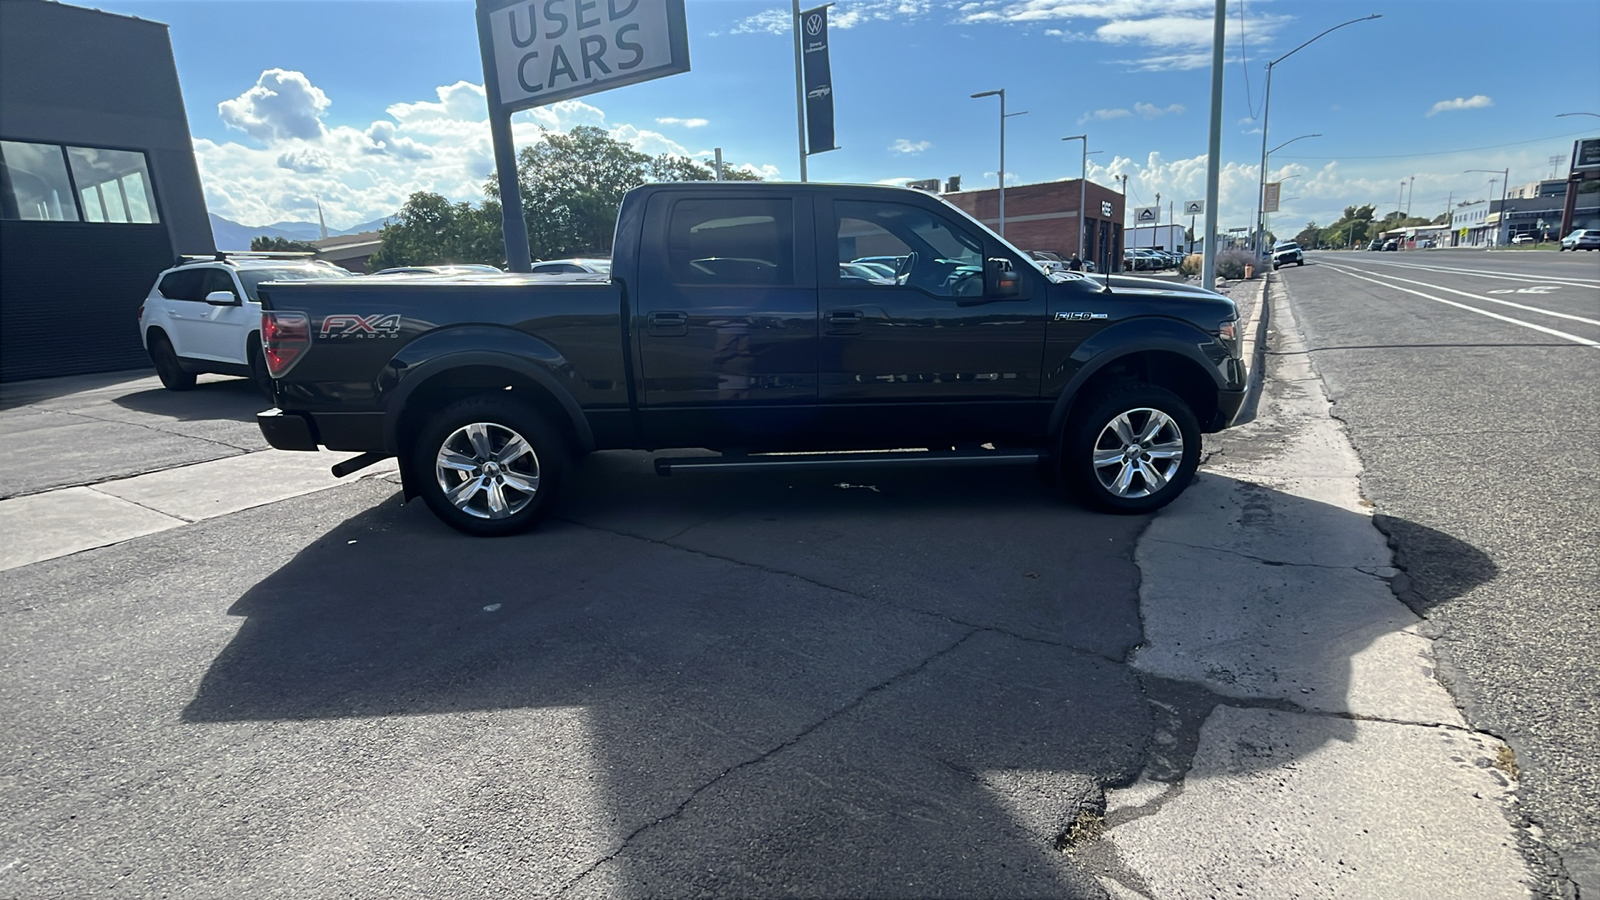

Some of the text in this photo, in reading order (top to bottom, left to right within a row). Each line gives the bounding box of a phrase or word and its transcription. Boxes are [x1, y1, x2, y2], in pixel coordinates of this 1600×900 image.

[508, 0, 641, 49] USED
[517, 23, 644, 93] CARS
[320, 314, 401, 333] FX4
